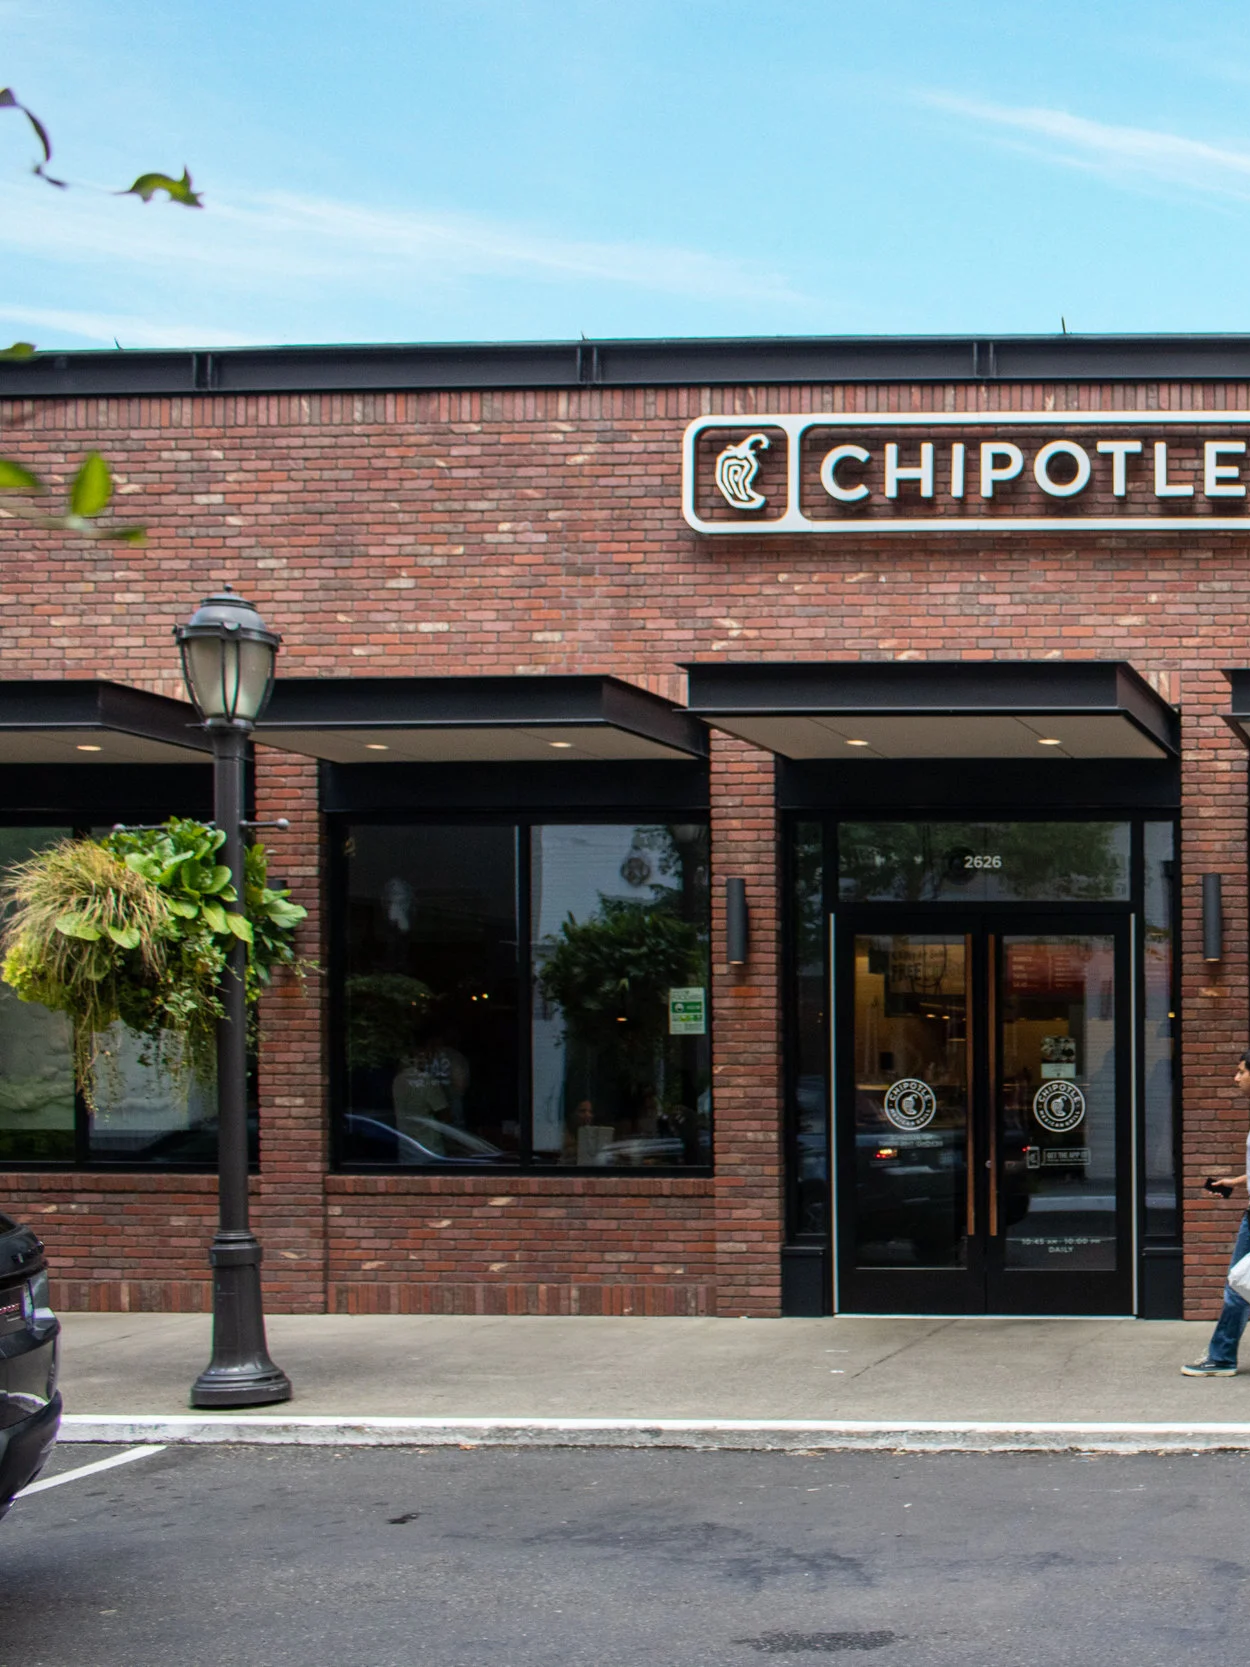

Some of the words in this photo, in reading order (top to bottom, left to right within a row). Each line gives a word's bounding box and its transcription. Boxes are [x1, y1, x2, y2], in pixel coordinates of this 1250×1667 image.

[819, 439, 1247, 501] CHIPOTLE
[963, 855, 1002, 869] 2626
[888, 1081, 932, 1101] CHIPOTLE
[1037, 1083, 1081, 1103] CHIPOTLE
[1047, 1246, 1073, 1254] DAILY
